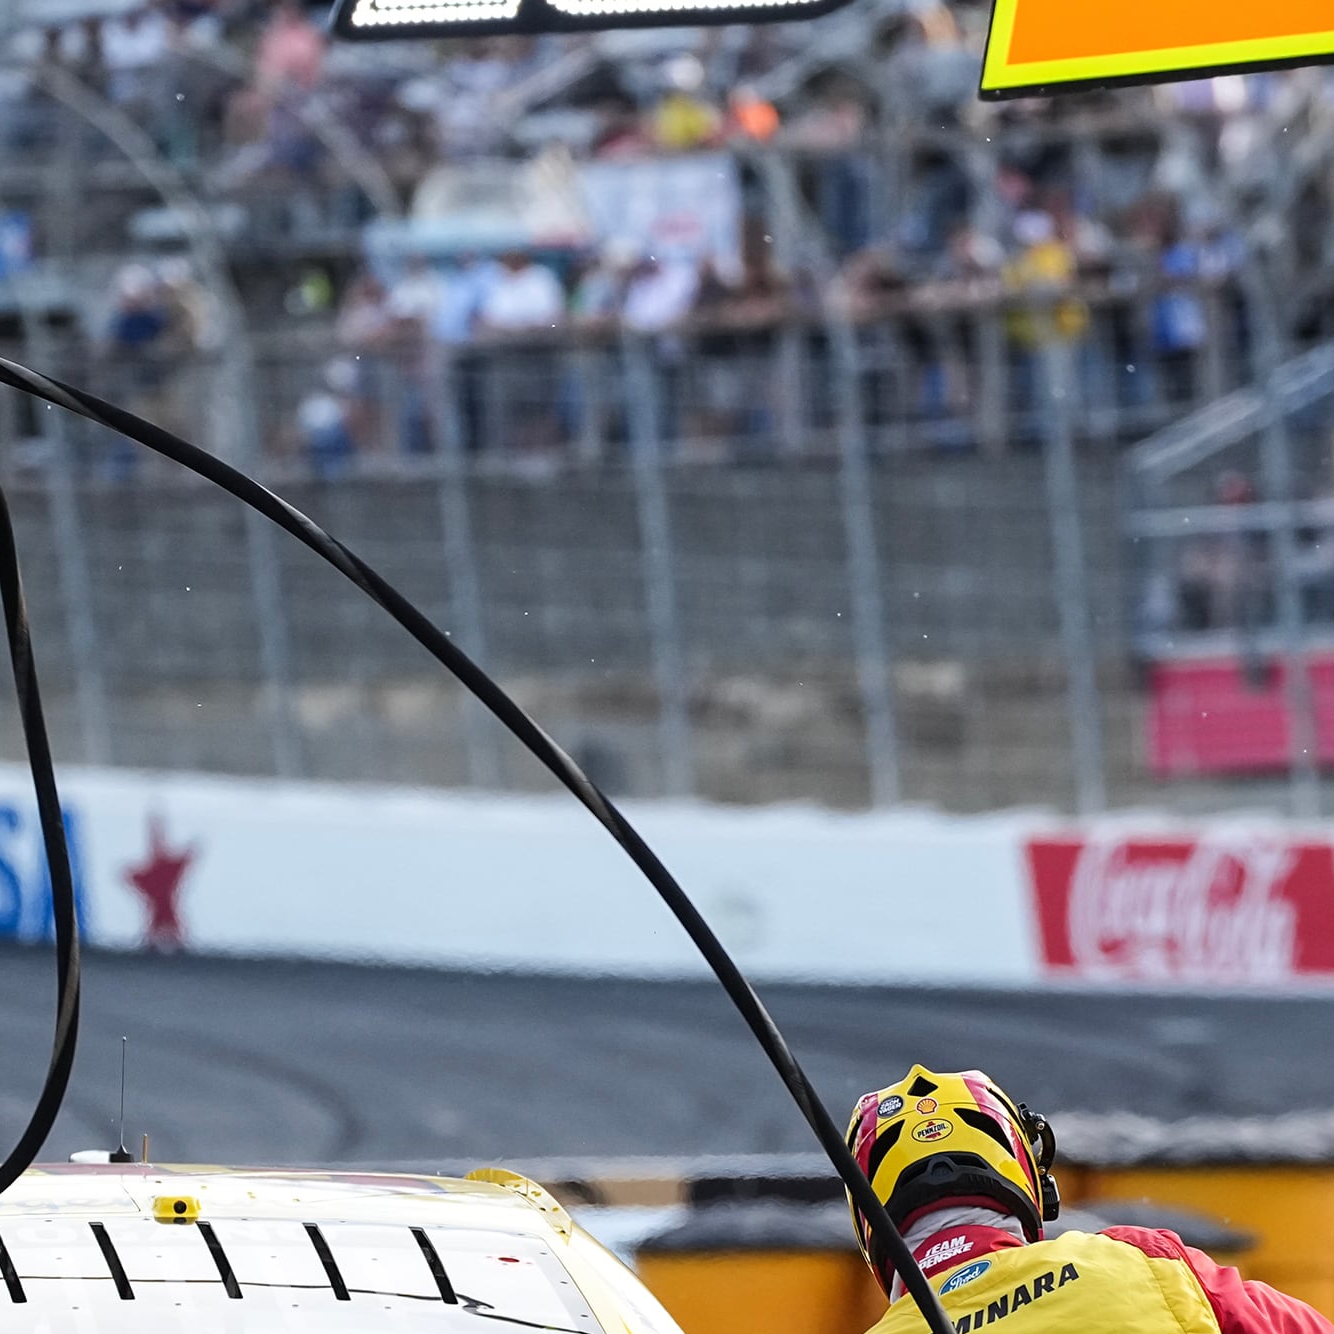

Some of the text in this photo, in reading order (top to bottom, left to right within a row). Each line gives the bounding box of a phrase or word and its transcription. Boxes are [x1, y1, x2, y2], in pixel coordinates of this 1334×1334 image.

[917, 1123, 947, 1138] PENNZOIL
[918, 1242, 974, 1270] PENSKE
[925, 1235, 966, 1256] TEAM
[949, 1265, 982, 1291] Ford
